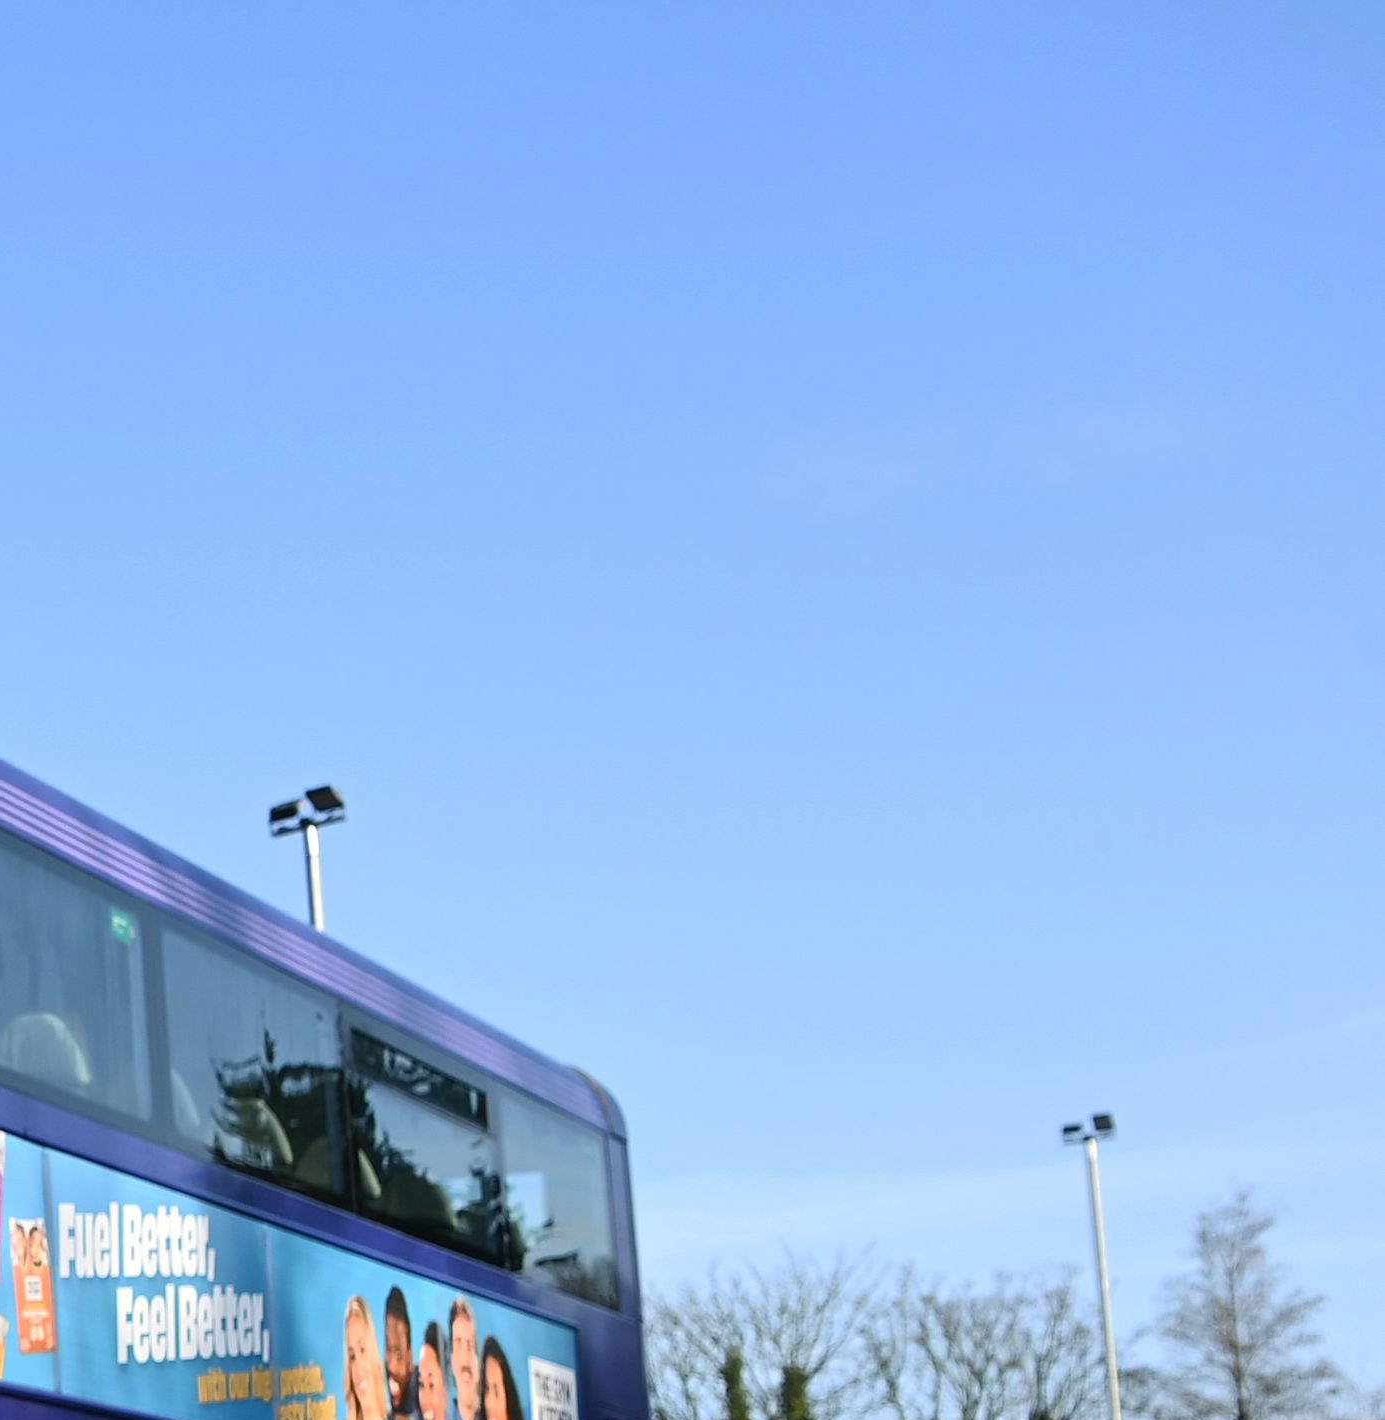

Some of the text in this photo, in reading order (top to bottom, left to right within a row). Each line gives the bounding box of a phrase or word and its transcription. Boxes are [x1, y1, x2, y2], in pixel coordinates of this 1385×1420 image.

[58, 1201, 216, 1282] Fuel Better,
[116, 1283, 270, 1365] Feel Better,
